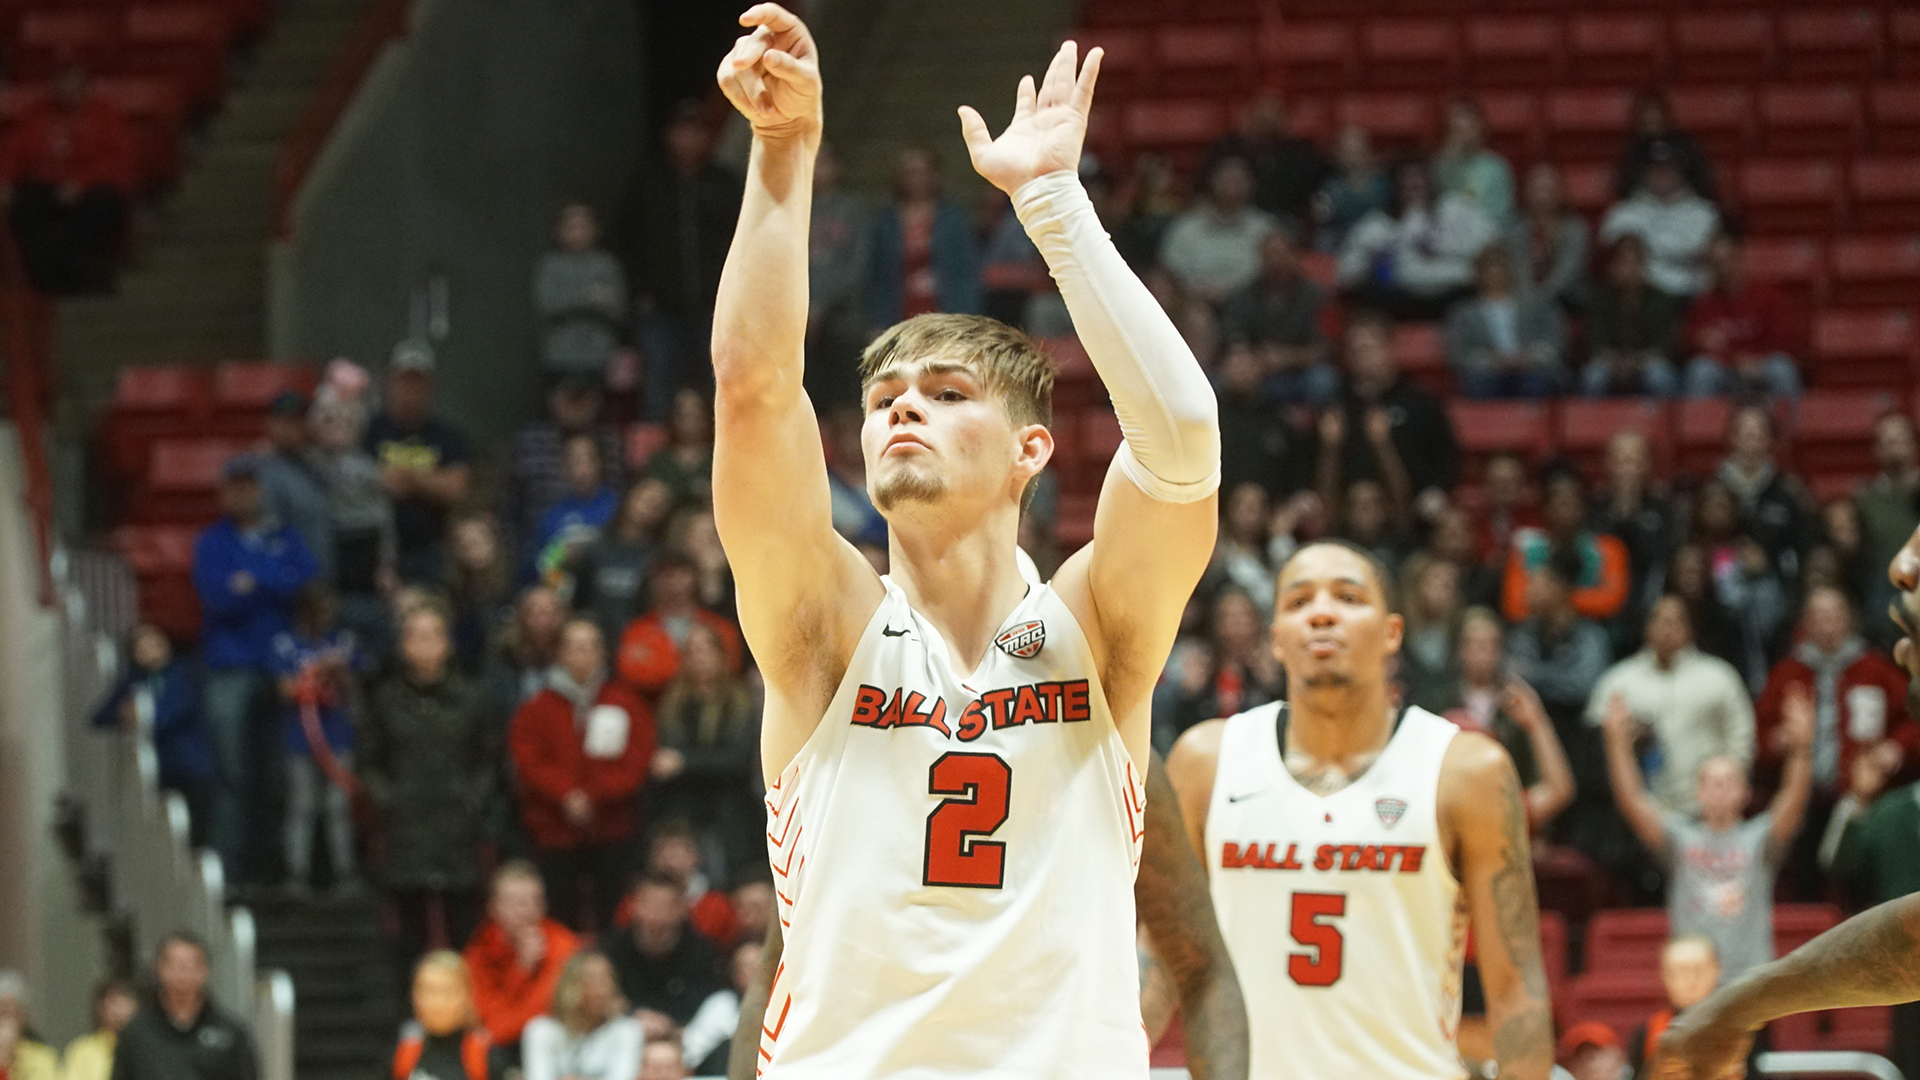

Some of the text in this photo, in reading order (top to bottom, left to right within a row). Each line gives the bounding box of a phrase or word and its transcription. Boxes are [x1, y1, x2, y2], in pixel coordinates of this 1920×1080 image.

[1002, 627, 1045, 654] MAC
[850, 679, 1090, 742] BALL STATE
[922, 751, 1012, 889] 2
[1222, 842, 1426, 872] BALL STATE
[1287, 892, 1346, 987] 5
